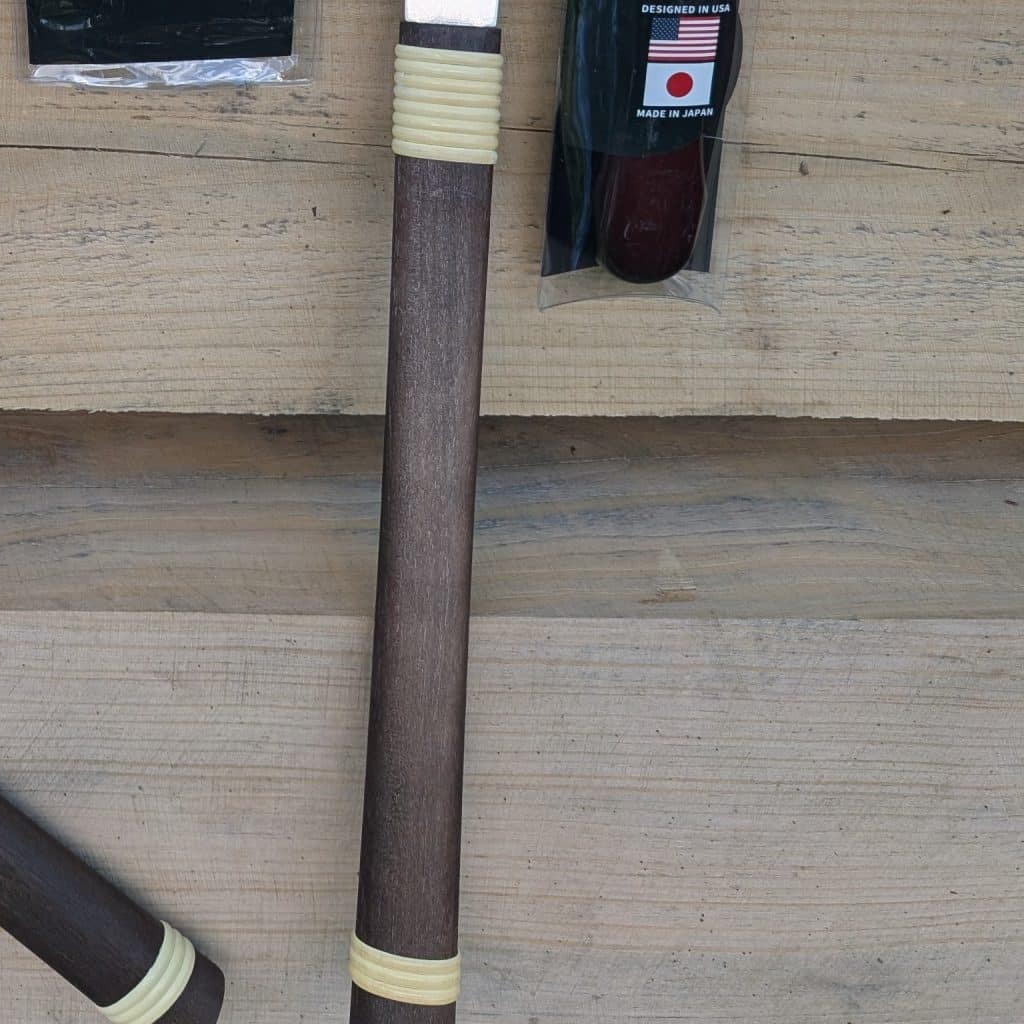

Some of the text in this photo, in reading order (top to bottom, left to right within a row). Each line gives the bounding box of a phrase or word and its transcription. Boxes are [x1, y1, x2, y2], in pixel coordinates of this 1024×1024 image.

[642, 4, 730, 14] DESIGNED IN USA
[636, 108, 713, 118] MADE IN JAPAN
